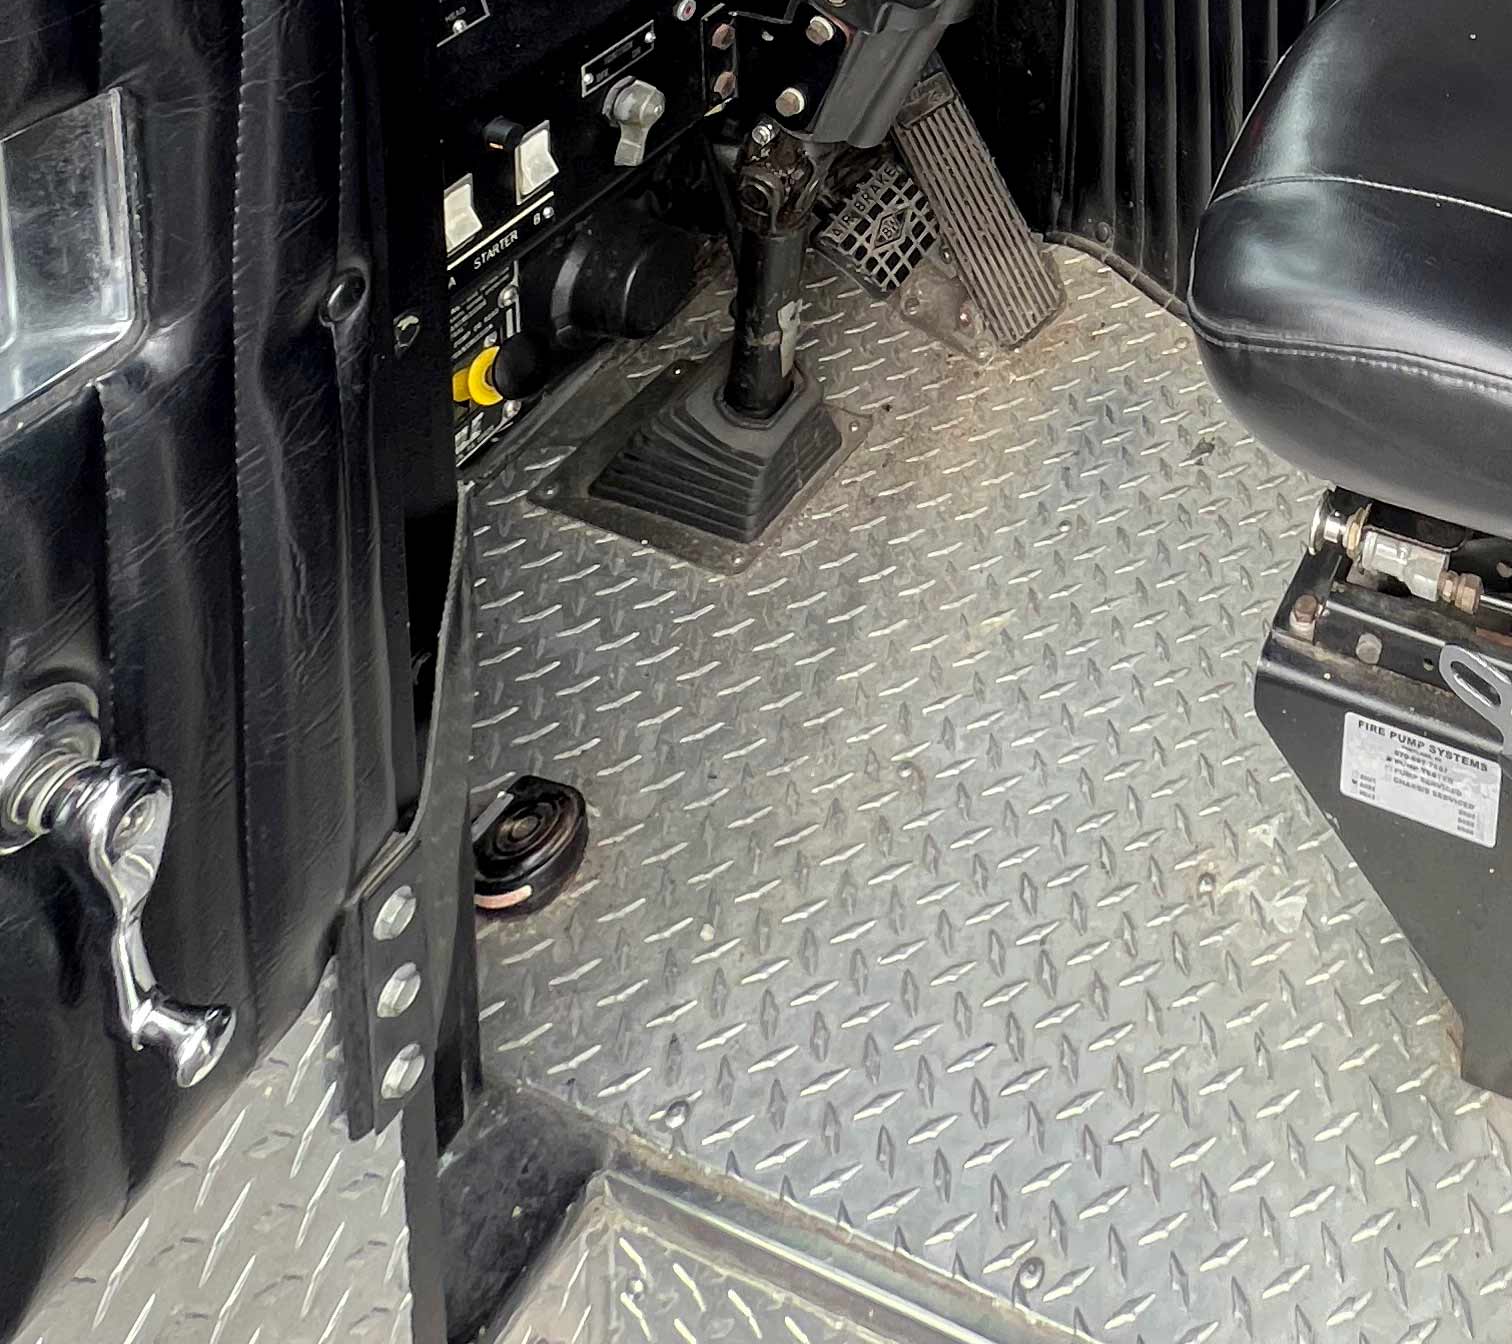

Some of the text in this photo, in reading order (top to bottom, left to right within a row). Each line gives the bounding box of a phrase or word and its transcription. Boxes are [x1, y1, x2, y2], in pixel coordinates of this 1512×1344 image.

[533, 213, 541, 226] B
[473, 229, 519, 270] STARTER
[1358, 719, 1386, 737] FIRE
[1389, 730, 1426, 749] PUMP
[1429, 744, 1488, 772] SYSTEMS
